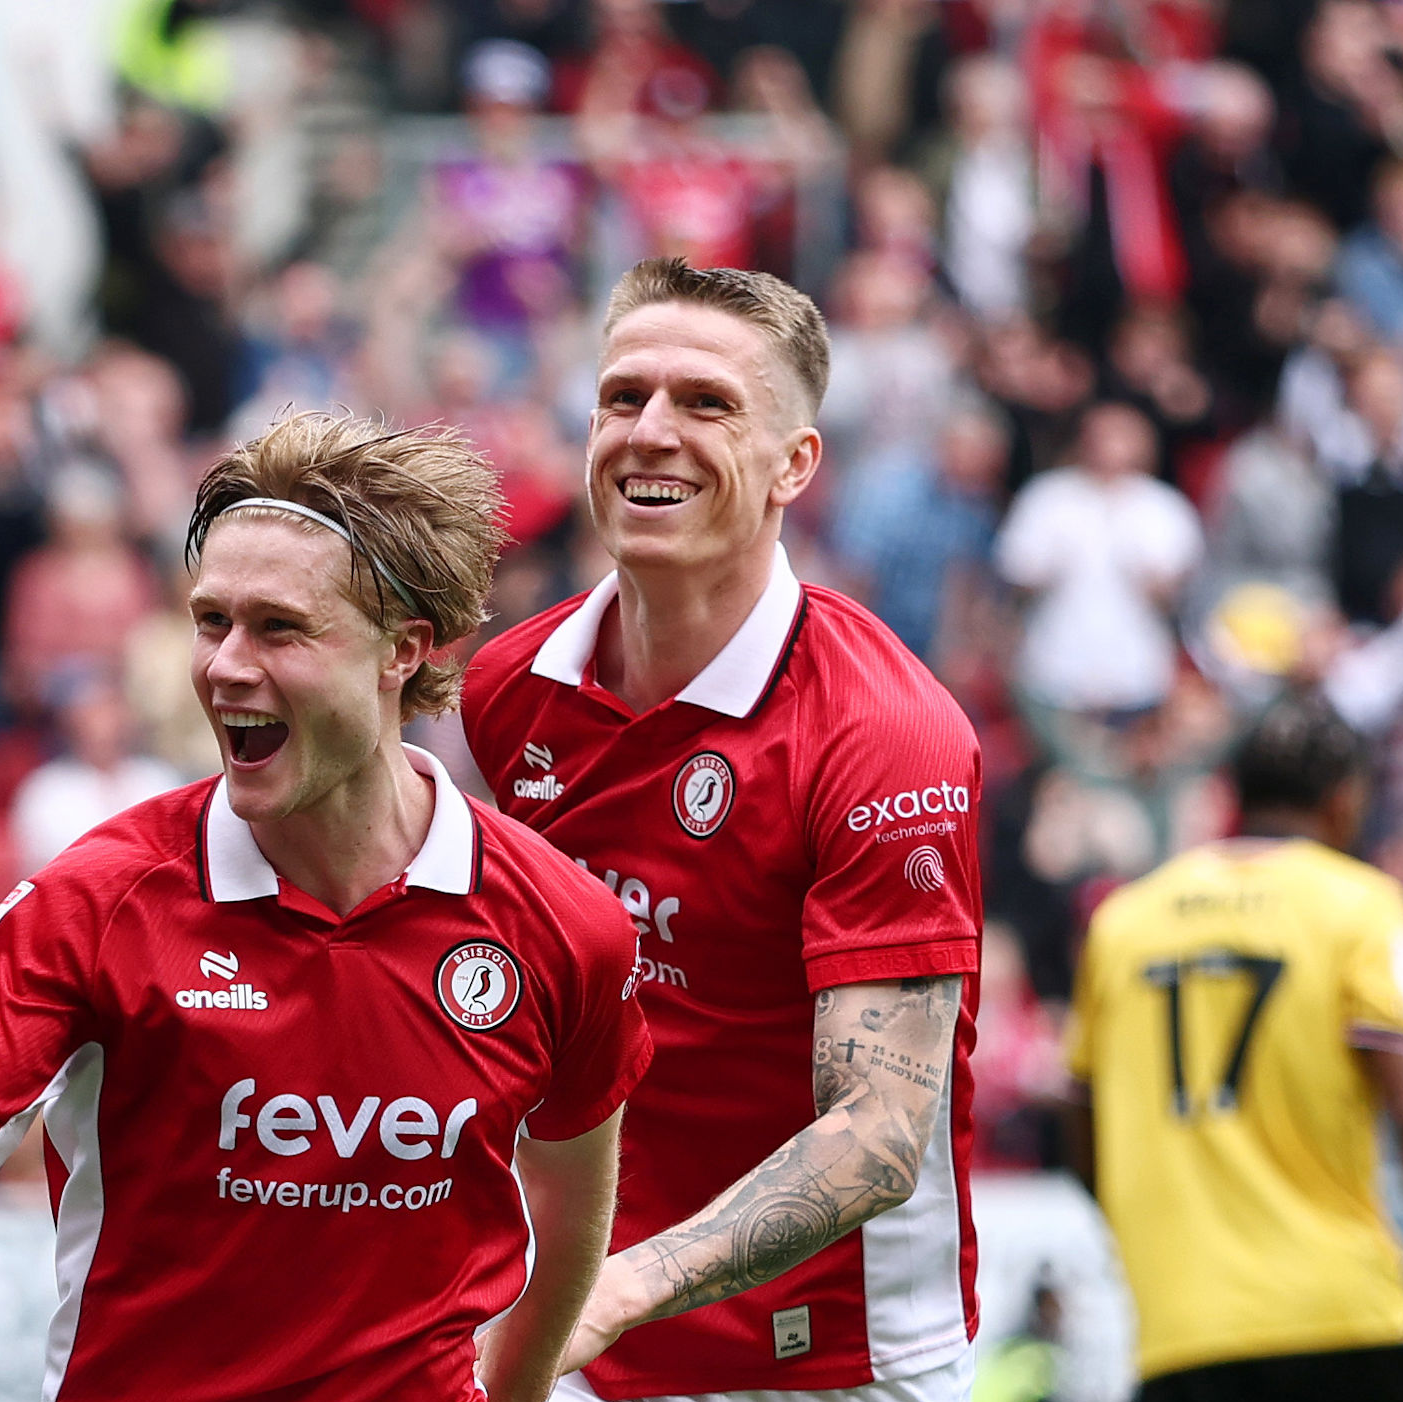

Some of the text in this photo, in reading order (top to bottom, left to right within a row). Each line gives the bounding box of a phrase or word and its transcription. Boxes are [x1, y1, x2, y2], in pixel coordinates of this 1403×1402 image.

[847, 780, 969, 832] exacta
[876, 818, 957, 844] technologies
[453, 947, 507, 968] BRISTOL
[175, 983, 269, 1010] o'neills
[461, 1012, 493, 1025] CITY
[1143, 946, 1288, 1119] 17
[218, 1078, 478, 1161] fever
[216, 1167, 453, 1213] feverup.com
